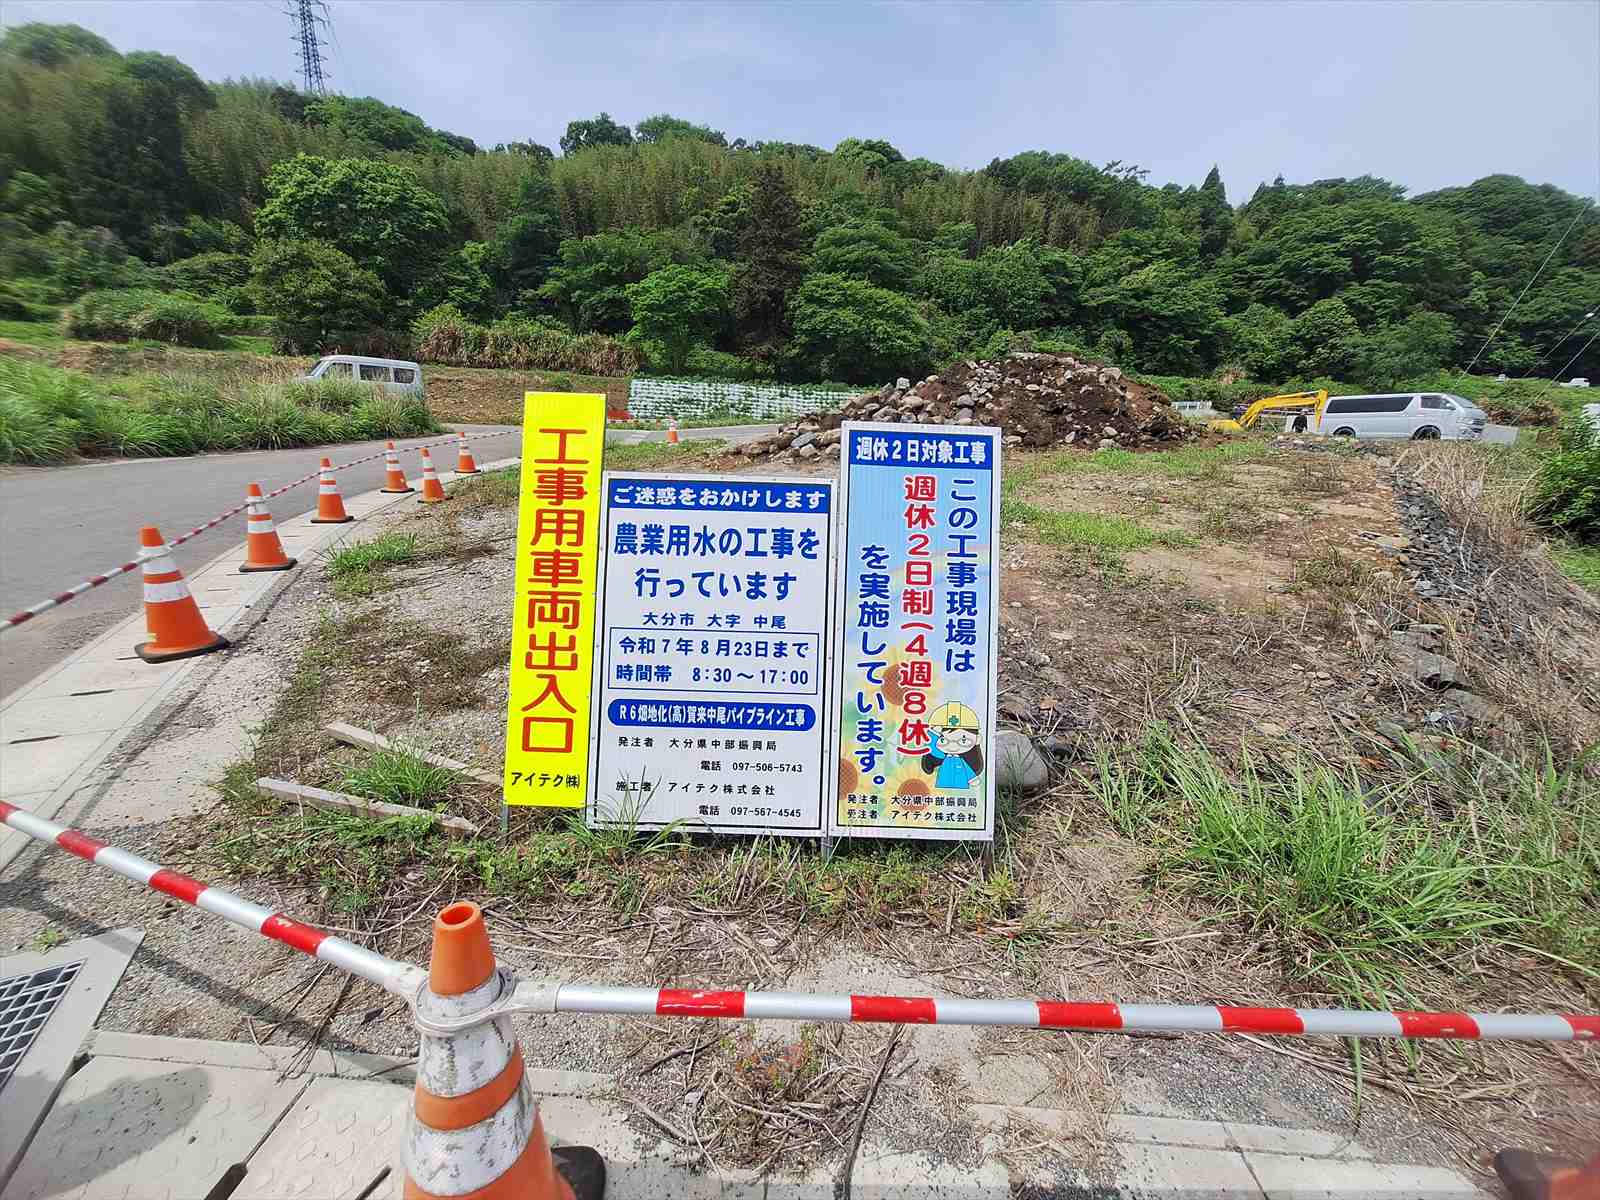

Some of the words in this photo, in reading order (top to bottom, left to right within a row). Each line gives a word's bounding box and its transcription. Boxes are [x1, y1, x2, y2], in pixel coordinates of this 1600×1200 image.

[855, 436, 987, 465] 週休2日対象工事
[613, 484, 826, 509] ご迷惑をおかけします
[613, 522, 820, 560] 農業用水の工事を
[634, 567, 797, 600] 行っています
[945, 478, 978, 673] この工事現場は
[521, 427, 588, 753] 工事用車両出入口
[643, 612, 695, 627] 大分市
[706, 613, 741, 628] 大字
[753, 615, 787, 630] 中尾
[618, 636, 810, 659] 令和7年8月23日まで
[615, 664, 672, 683] 時間帯
[854, 543, 890, 786] を実施しています。
[618, 736, 655, 748] 発注者
[668, 737, 778, 752] 大分県中部振興局
[700, 760, 721, 772] 電話
[615, 781, 652, 793] 施工者
[667, 781, 776, 796] アイテク株式会社
[698, 805, 720, 817] 電話
[847, 794, 879, 806] 発注者
[891, 795, 977, 809] 大分県中部振興局
[890, 809, 977, 823] アイテク株式会社
